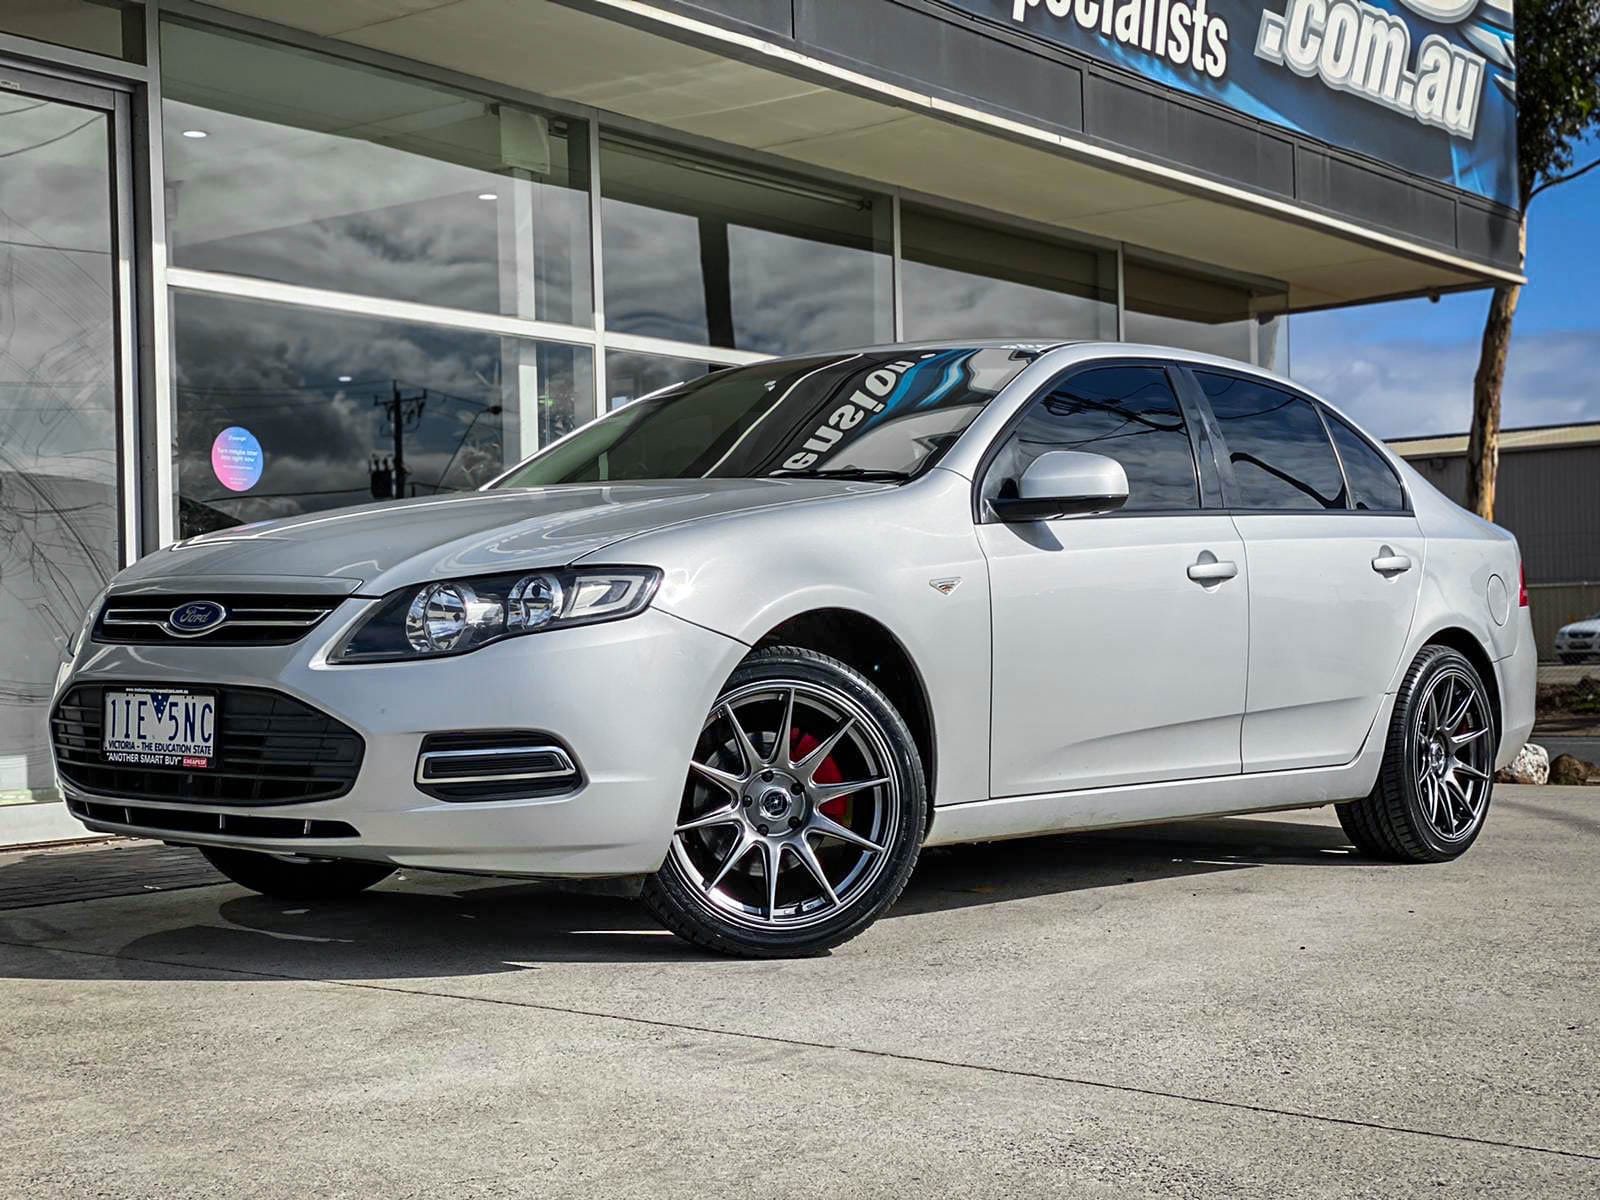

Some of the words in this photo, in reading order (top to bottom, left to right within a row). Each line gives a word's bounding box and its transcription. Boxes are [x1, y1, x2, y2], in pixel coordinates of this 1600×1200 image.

[1257, 0, 1484, 137] .com.au
[180, 606, 212, 623] Ford
[168, 701, 213, 743] 5NC
[108, 740, 136, 750] VICTORIA
[141, 742, 153, 751] THE
[154, 743, 191, 753] EDUCATION
[193, 745, 212, 755] STATE
[140, 754, 164, 764] SMART
